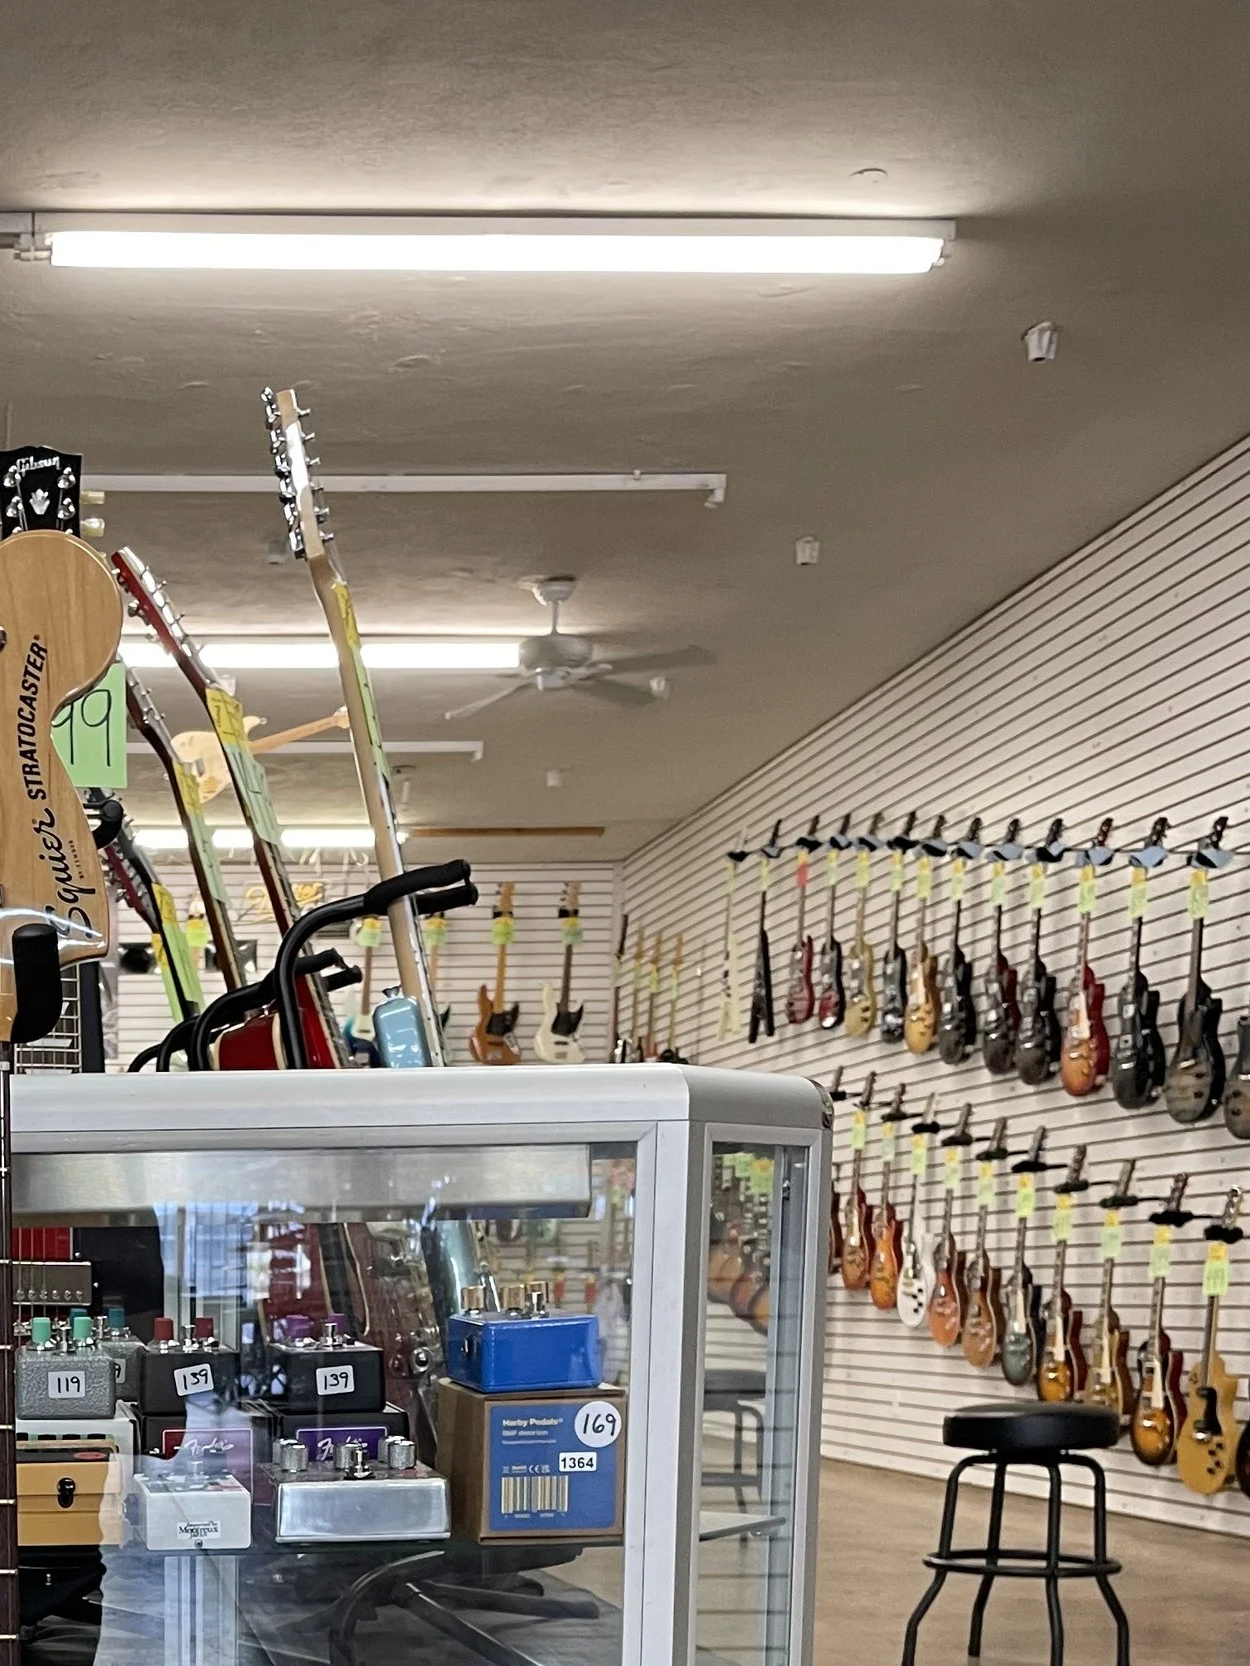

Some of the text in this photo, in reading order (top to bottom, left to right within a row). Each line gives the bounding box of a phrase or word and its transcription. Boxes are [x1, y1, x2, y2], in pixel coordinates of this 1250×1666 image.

[16, 456, 61, 477] Gibson
[17, 643, 48, 801] STRATOCASTER
[32, 808, 96, 939] Squier
[56, 1375, 81, 1394] 119
[324, 1371, 349, 1391] 139
[582, 1413, 617, 1436] 169
[560, 1456, 595, 1469] 1364
